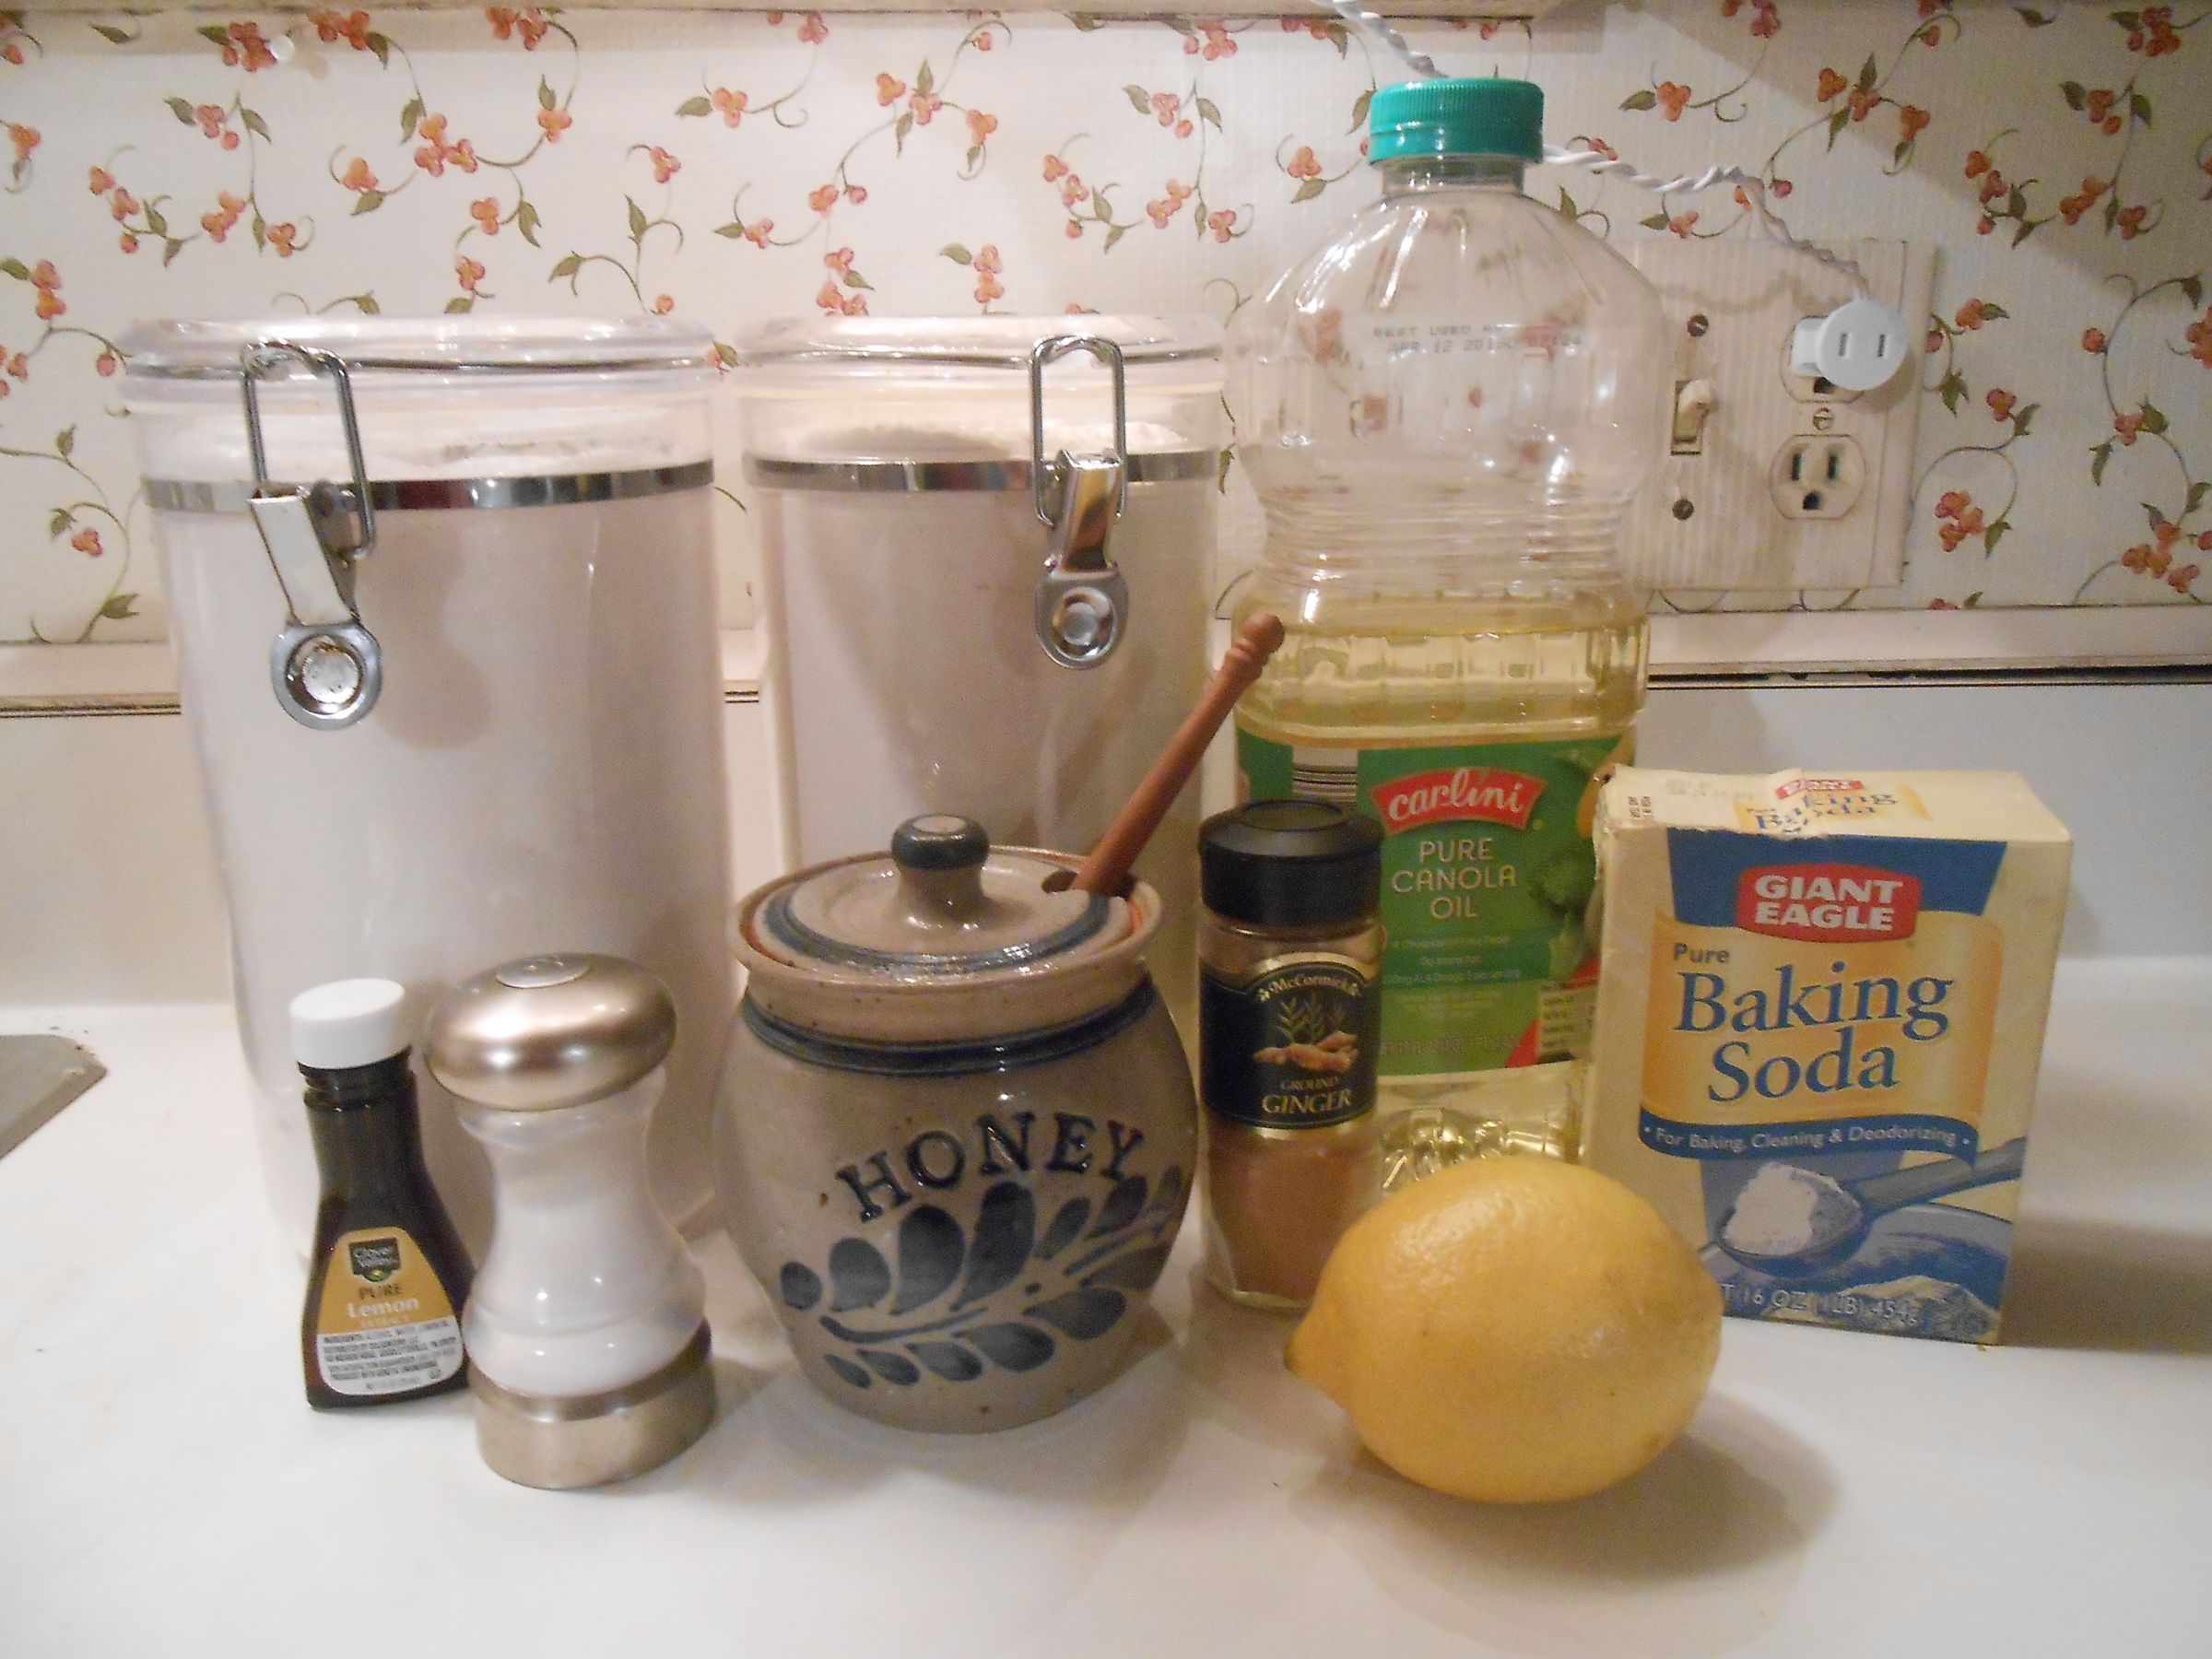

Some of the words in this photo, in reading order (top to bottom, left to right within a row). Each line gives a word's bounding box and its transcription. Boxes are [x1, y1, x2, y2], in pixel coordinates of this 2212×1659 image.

[1388, 767, 1525, 821] carlini
[1418, 837, 1494, 863] PURE
[1391, 865, 1517, 893] CANOLA
[1755, 875, 1903, 903] GIANT
[1430, 896, 1478, 919] OIL
[1755, 901, 1894, 931] EAGLE
[1673, 943, 1730, 964] Pure
[1672, 960, 1955, 1041] Baking
[1708, 1026, 1900, 1102] Soda
[1262, 1089, 1351, 1113] GINGER
[1656, 1128, 1683, 1146] For
[1752, 1132, 1824, 1148] Cleaning
[1829, 1129, 1843, 1144] &
[1848, 1126, 1957, 1147] Deodorizing
[835, 1111, 1144, 1223] HONEY
[347, 1298, 419, 1318] Lemon
[1771, 1289, 1807, 1310] OZ
